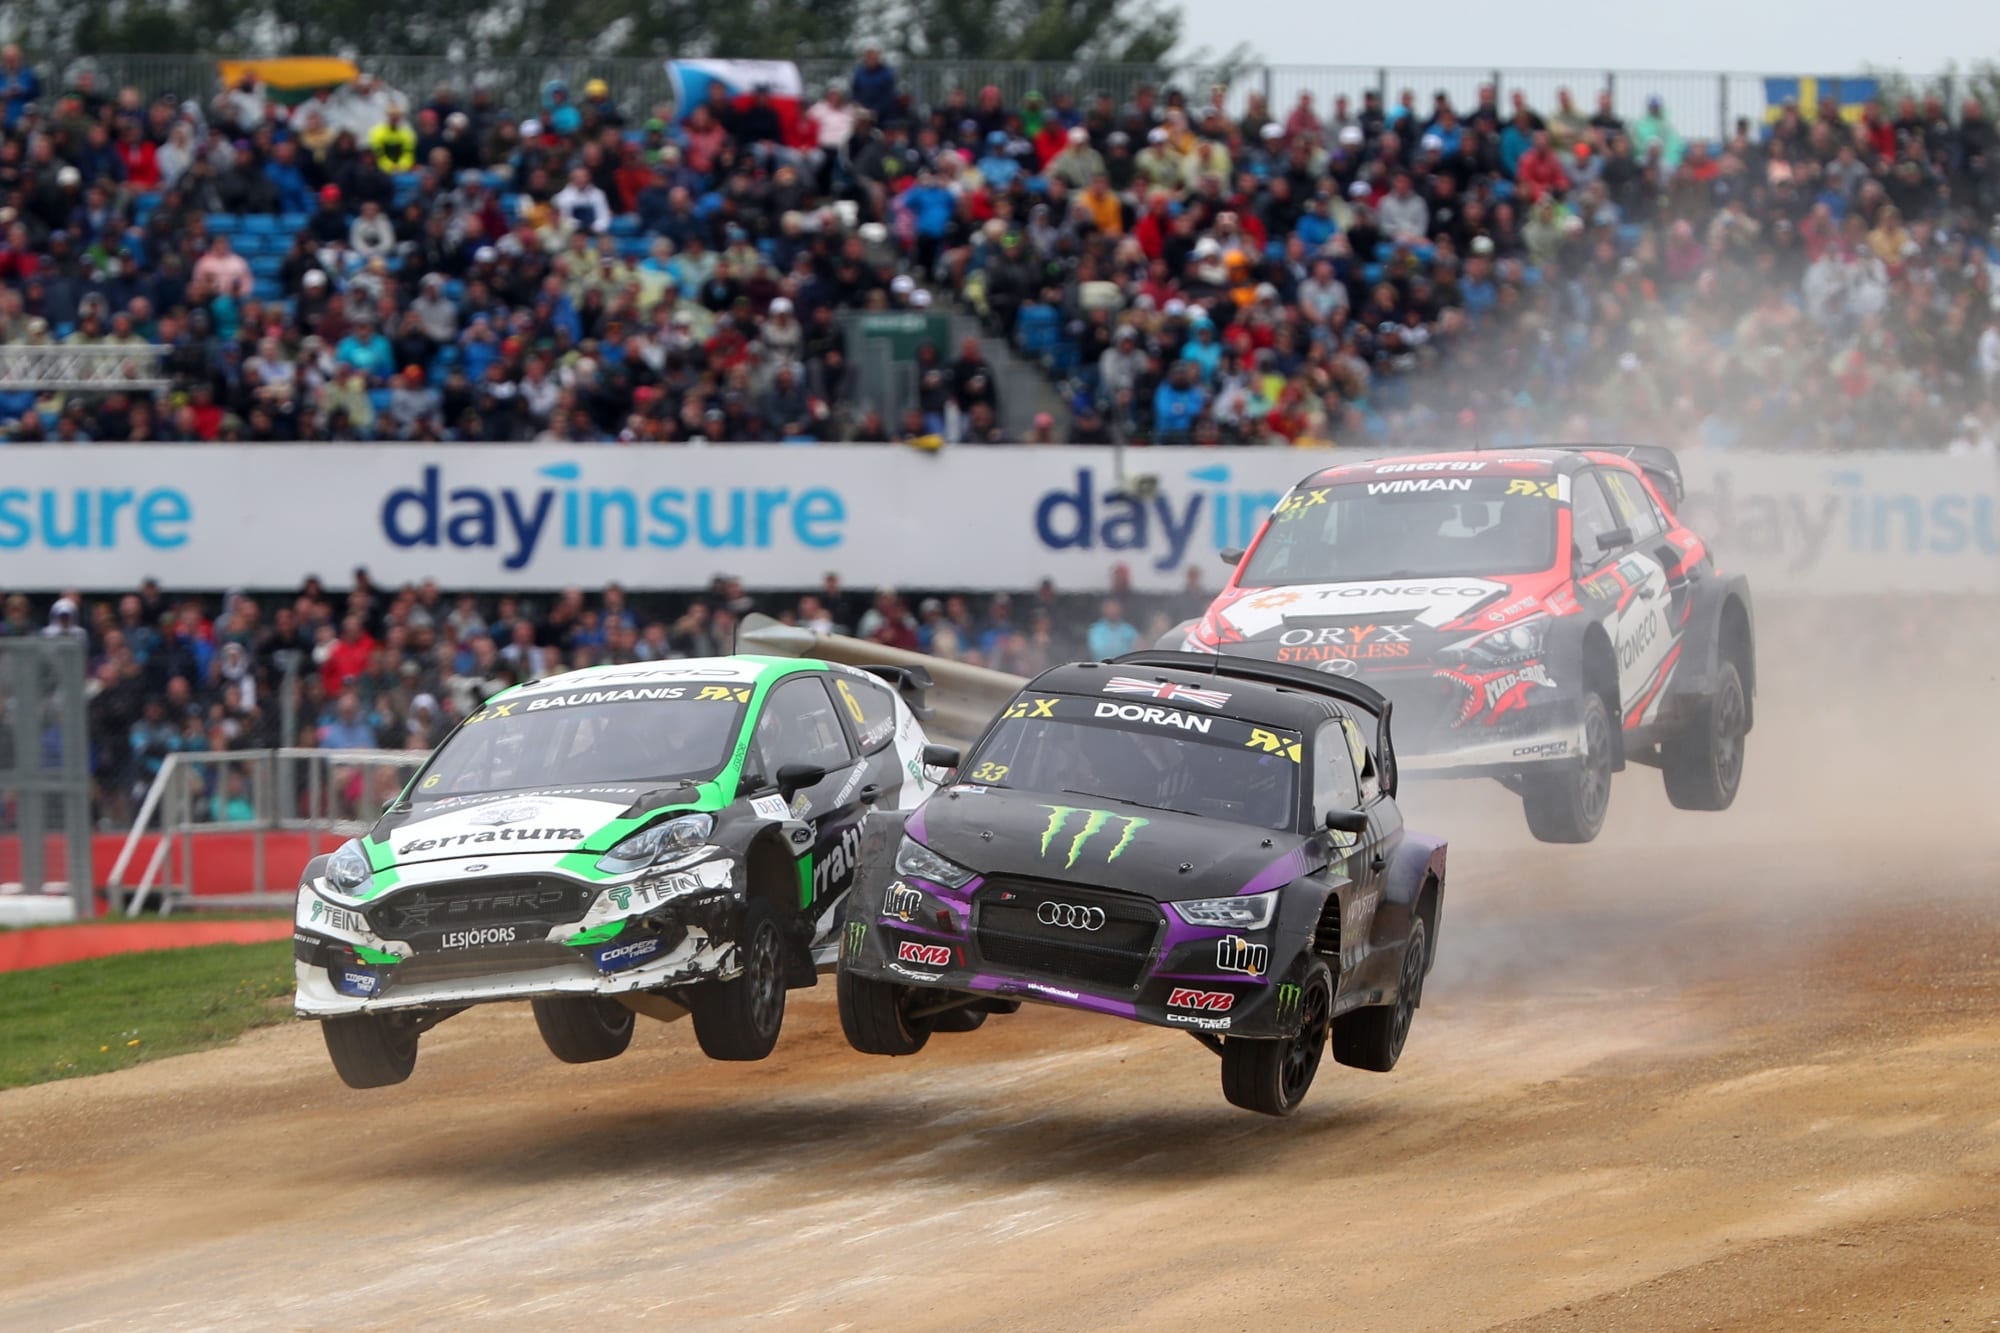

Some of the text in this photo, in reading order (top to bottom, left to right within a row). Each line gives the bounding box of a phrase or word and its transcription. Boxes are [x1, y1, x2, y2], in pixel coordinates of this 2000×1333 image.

[1367, 478, 1473, 496] WIMAN
[381, 461, 846, 571] dayinsure
[1279, 624, 1414, 647] ORYX
[1276, 642, 1412, 663] STAINLESS
[526, 686, 687, 712] BAUMANIS
[836, 679, 864, 724] 6
[1094, 702, 1213, 733] DORAN
[1512, 740, 1568, 758] COOPER
[422, 774, 441, 789] 6
[971, 761, 1009, 782] 33
[634, 873, 704, 904] TEIN
[323, 905, 360, 933] TEIN
[601, 939, 658, 961] COOPER
[898, 941, 951, 966] KYB
[1167, 987, 1234, 1012] KYB
[1166, 1013, 1231, 1025] COOPER
